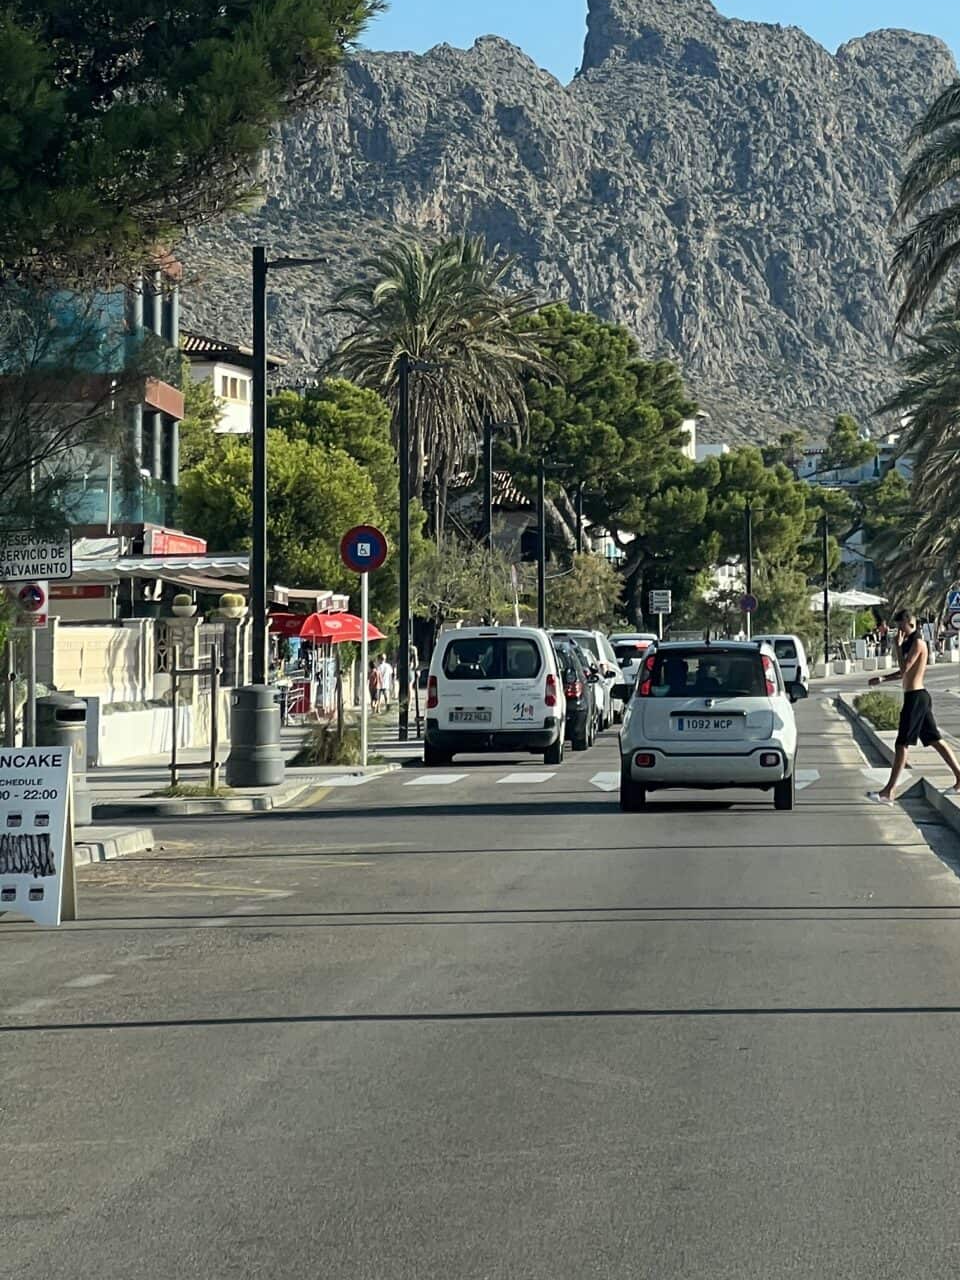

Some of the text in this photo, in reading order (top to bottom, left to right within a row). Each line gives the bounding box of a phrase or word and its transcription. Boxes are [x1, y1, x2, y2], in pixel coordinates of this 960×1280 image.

[0, 547, 65, 561] SERVICIO DE
[0, 562, 67, 576] SALVAMENTO
[687, 720, 711, 729] 1092
[0, 754, 62, 768] NCAKE
[23, 789, 58, 800] 22:00
